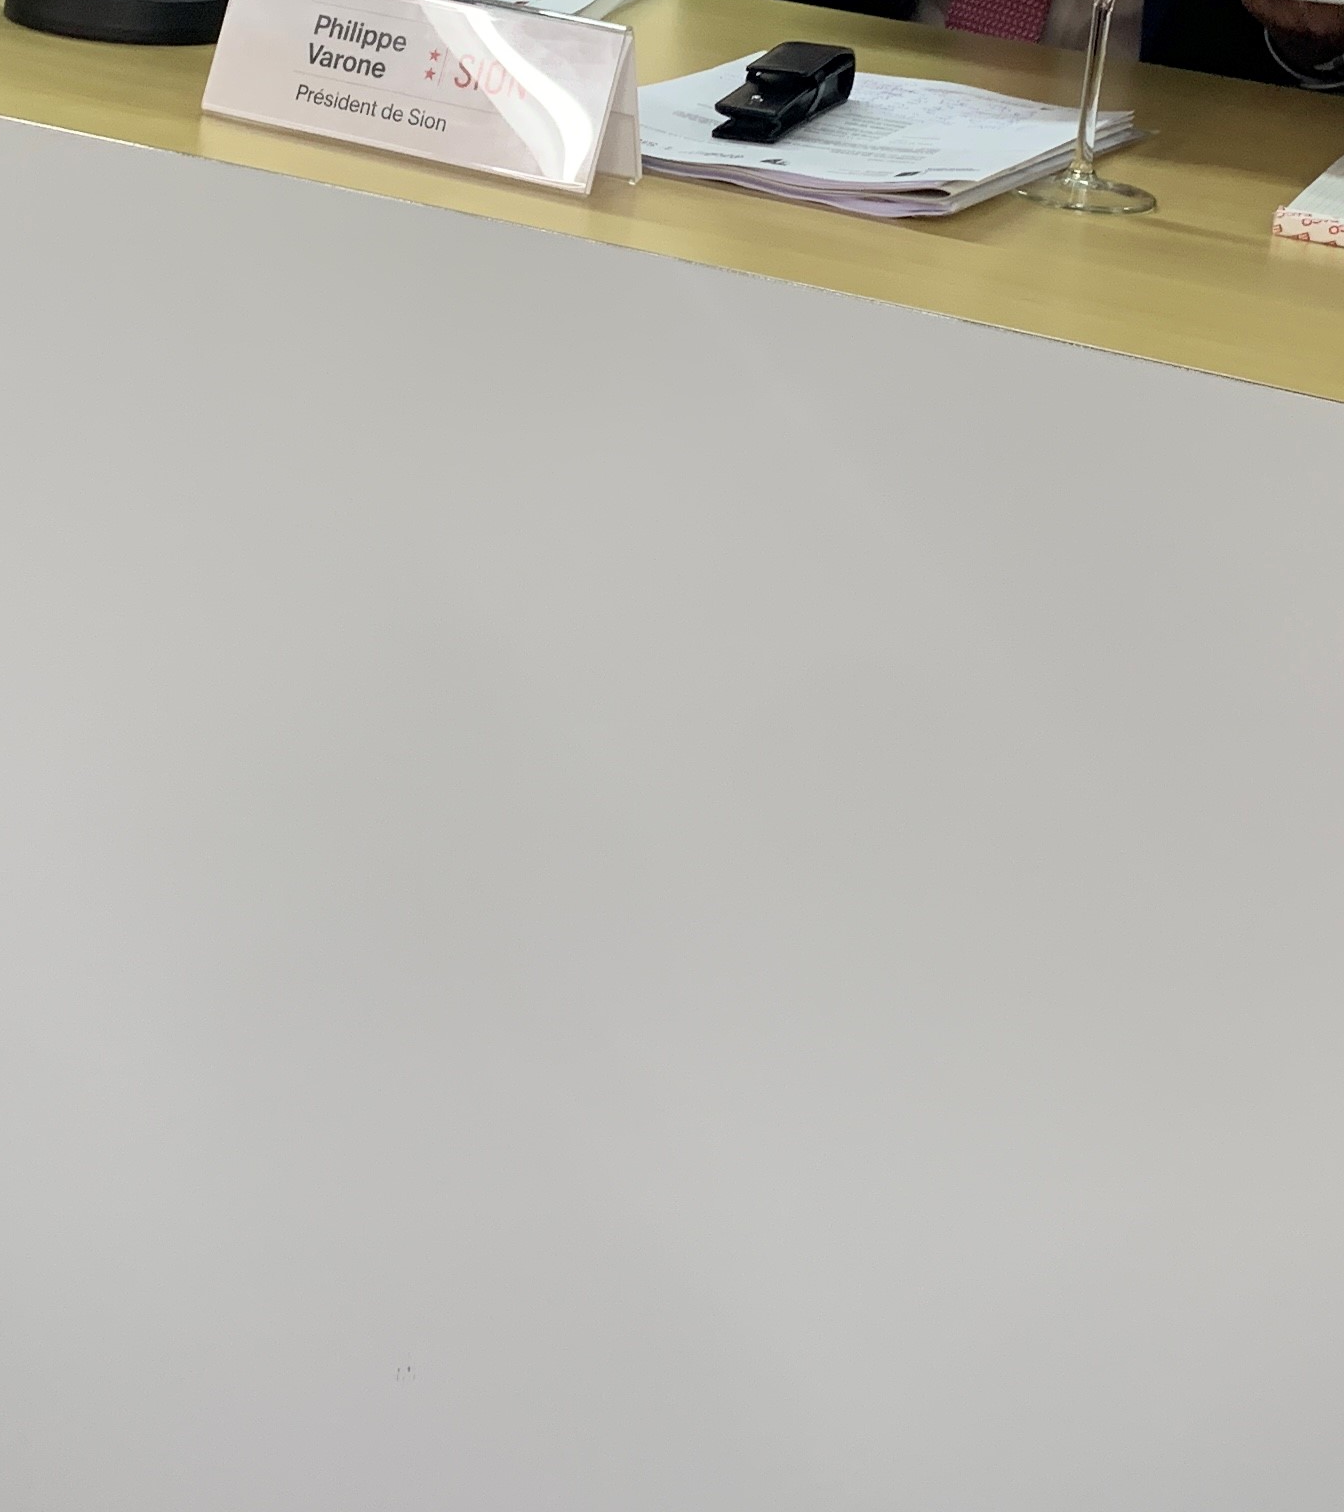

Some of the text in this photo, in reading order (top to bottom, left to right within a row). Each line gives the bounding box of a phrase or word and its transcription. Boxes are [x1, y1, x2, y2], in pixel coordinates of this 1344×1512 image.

[313, 14, 407, 52] Philippe
[309, 42, 386, 79] Varone
[295, 83, 447, 132] Président de Sion
